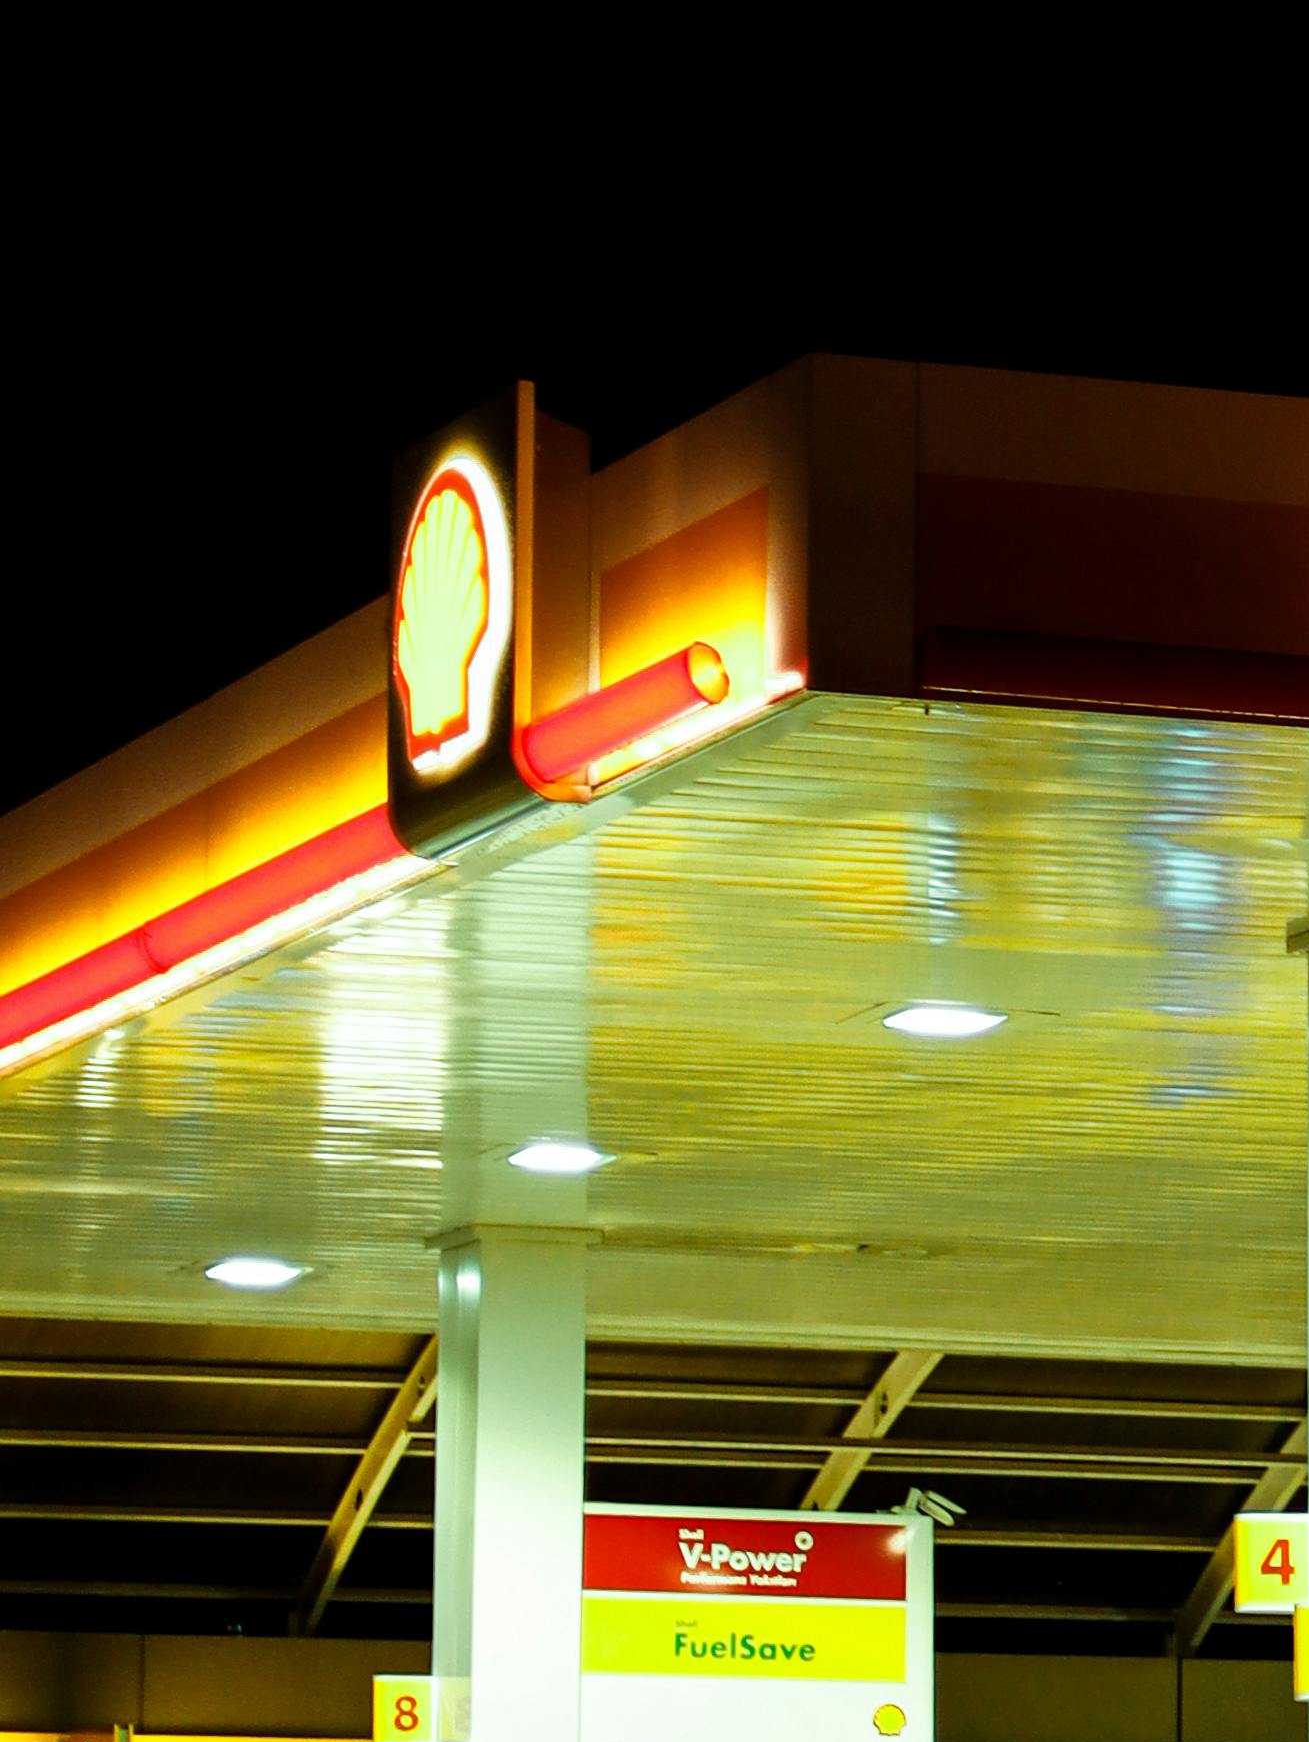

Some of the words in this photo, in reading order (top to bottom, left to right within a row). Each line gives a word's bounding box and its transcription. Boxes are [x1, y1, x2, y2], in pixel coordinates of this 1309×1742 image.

[679, 1542, 807, 1573] V-Power
[1261, 1539, 1295, 1586] 4
[675, 1633, 816, 1662] FuelSave
[394, 1696, 419, 1731] 8
